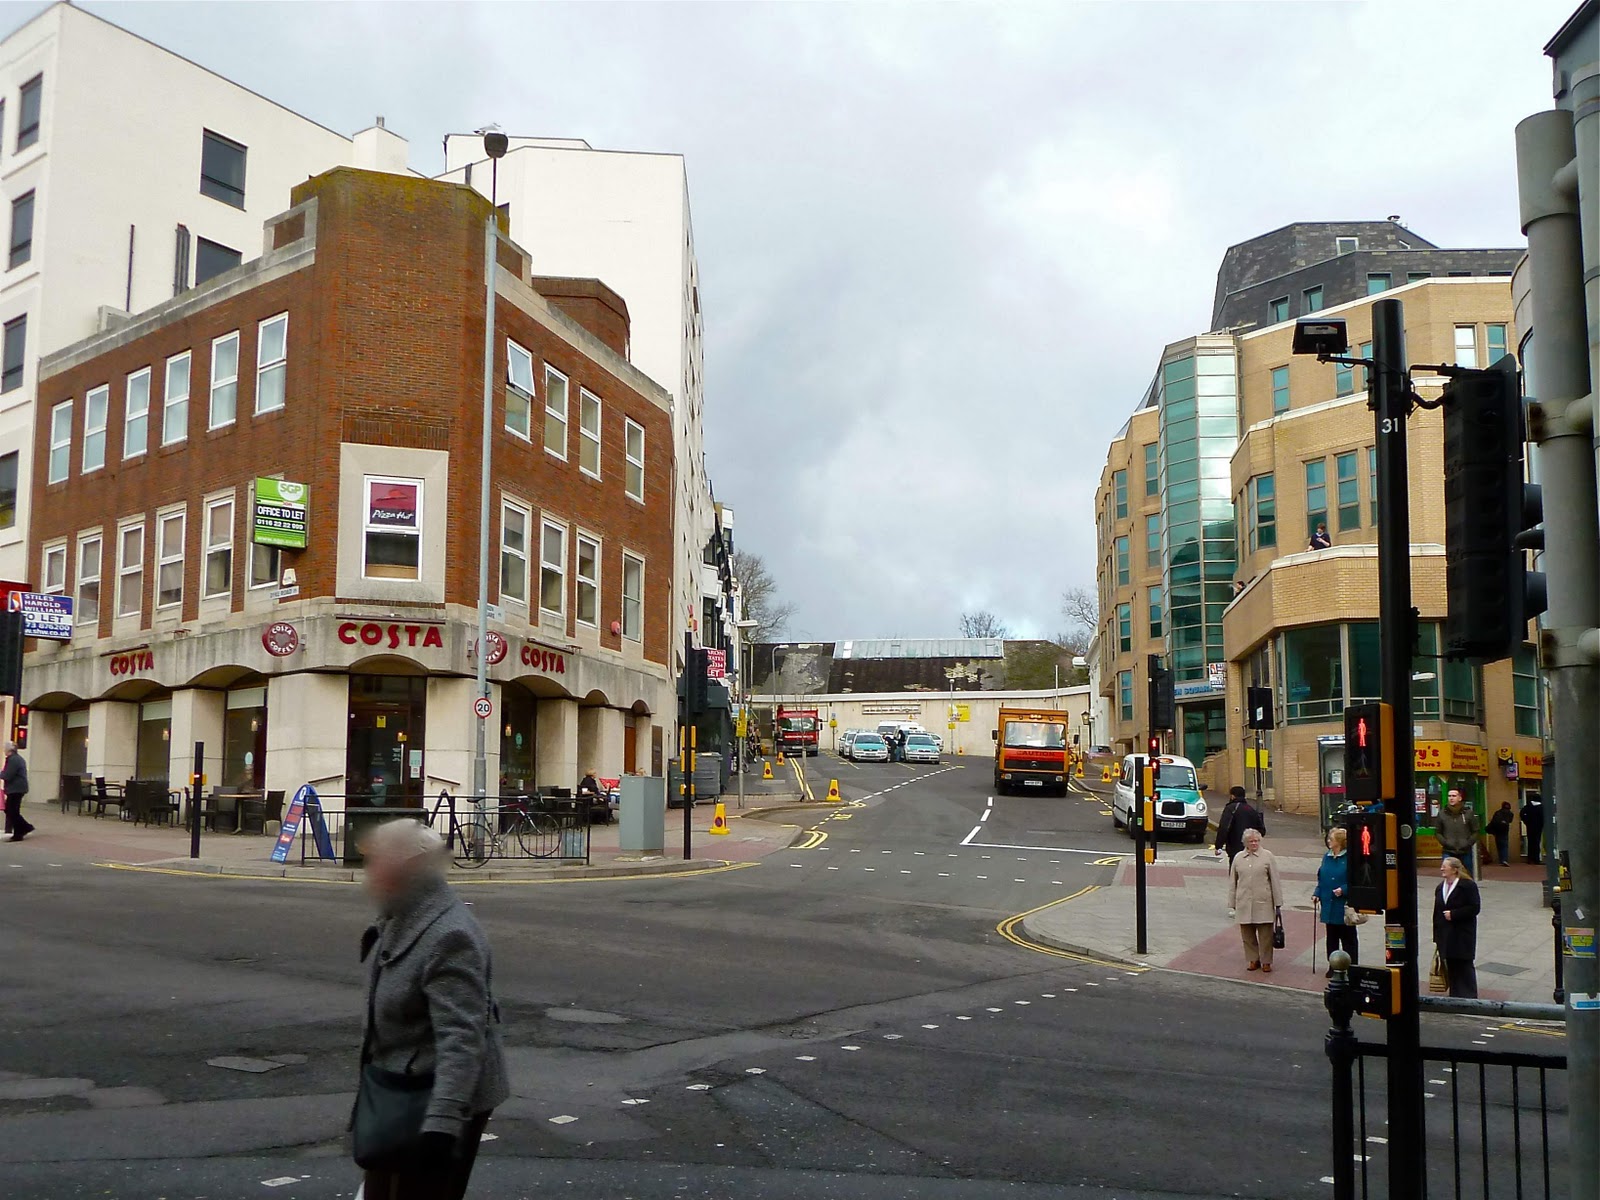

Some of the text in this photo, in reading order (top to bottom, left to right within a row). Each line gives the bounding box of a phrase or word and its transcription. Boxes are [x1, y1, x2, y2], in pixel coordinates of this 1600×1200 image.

[1381, 417, 1399, 433] 31
[280, 483, 302, 494] SGP
[257, 505, 305, 520] OFFICE TO LET
[372, 510, 415, 519] Pizza Hut
[24, 600, 61, 608] HAROLD
[24, 606, 67, 615] WILLIAMS
[40, 614, 64, 623] LET
[271, 625, 292, 635] COSTA
[337, 622, 443, 649] COSTA
[270, 641, 294, 653] COFFEE
[109, 651, 154, 676] COSTA
[520, 645, 565, 675] COSTA
[477, 703, 490, 713] 20
